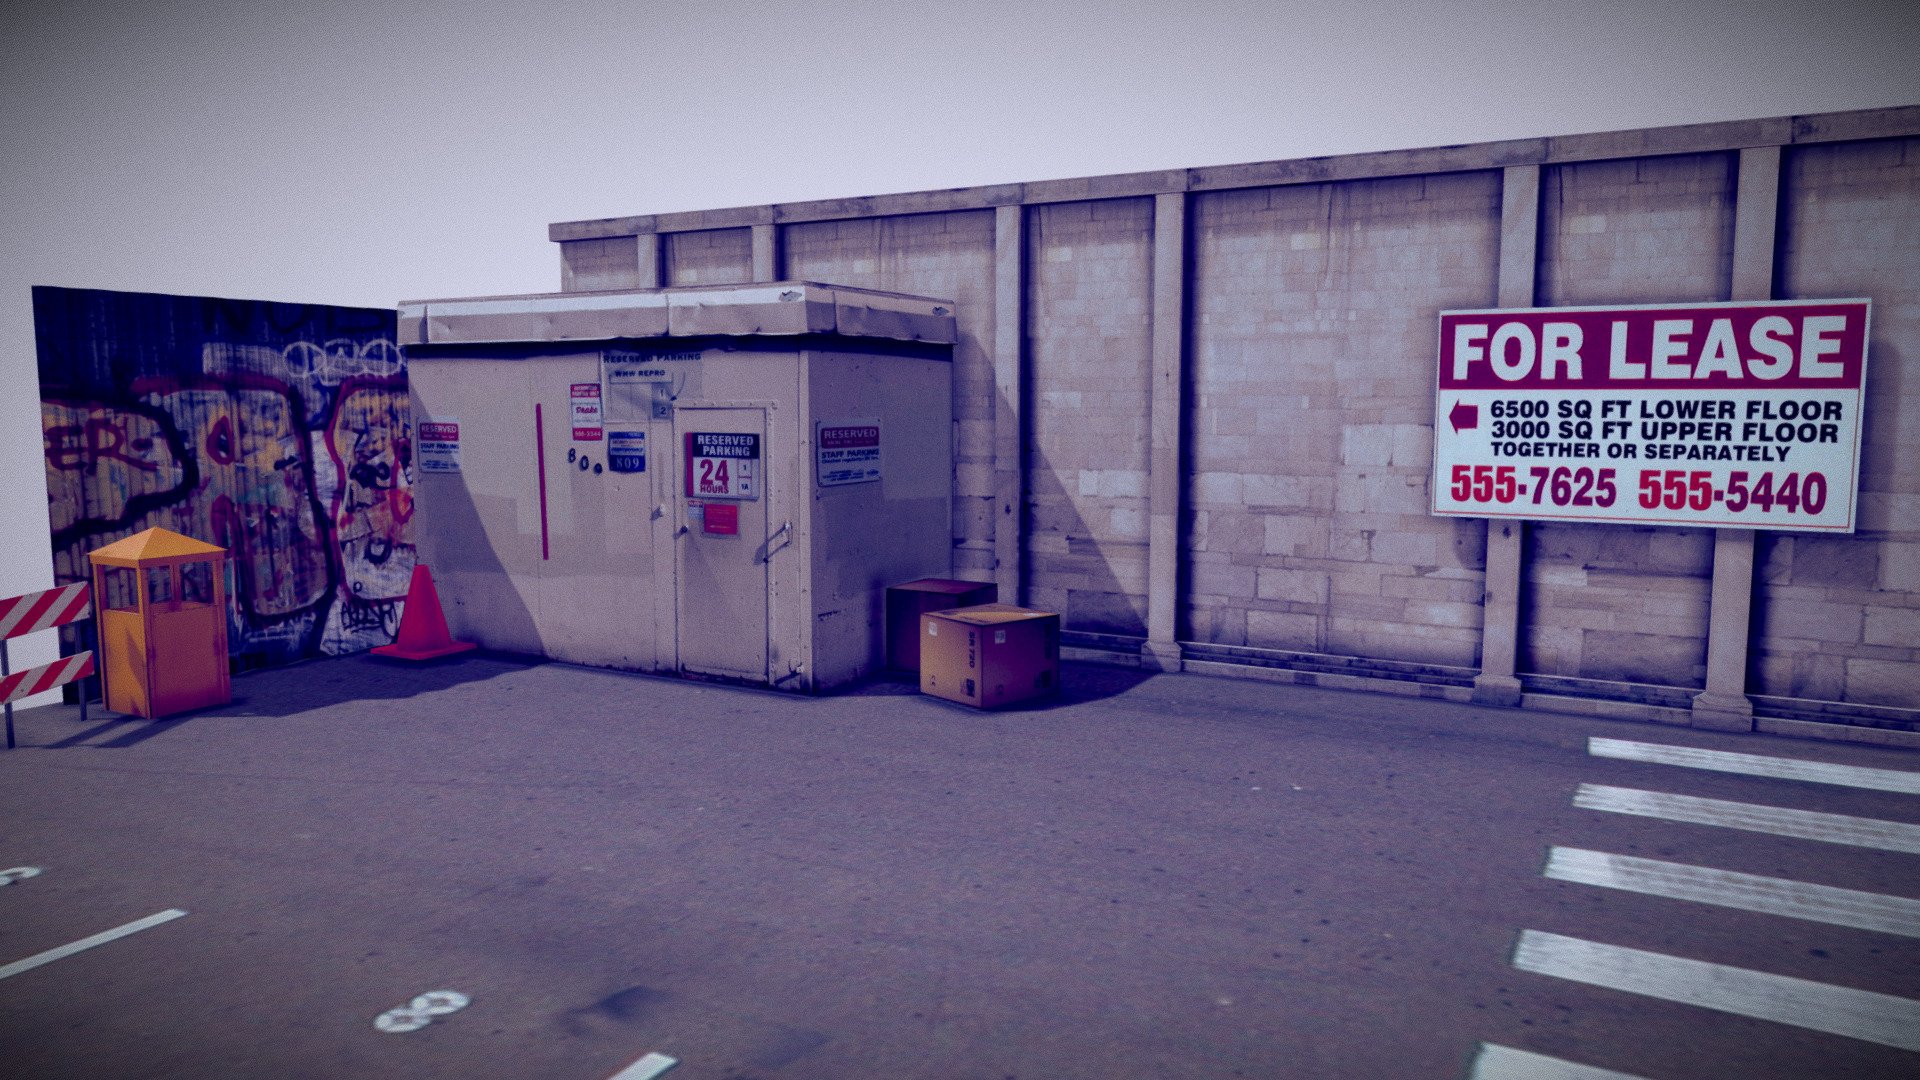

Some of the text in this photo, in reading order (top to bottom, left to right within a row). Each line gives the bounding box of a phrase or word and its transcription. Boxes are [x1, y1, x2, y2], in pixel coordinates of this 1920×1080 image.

[1453, 315, 1847, 382] FOR LEASE
[656, 353, 701, 362] PARKING
[638, 369, 666, 377] REPRO
[660, 406, 666, 415] 2
[1490, 399, 1843, 421] 6500 SQ FT LOWER FLOOR
[421, 425, 457, 433] RESERVED
[824, 429, 877, 439] RESERVED
[1491, 420, 1839, 443] 3000 SQ FT UPPER FLOOR
[697, 434, 754, 446] RESERVED
[703, 446, 750, 456] PARKING
[847, 448, 879, 457] PARKING
[1490, 441, 1791, 462] TOGETHER OR SEPARATELY
[616, 457, 640, 469] 809
[700, 459, 729, 486] 24
[700, 484, 729, 494] HOURS
